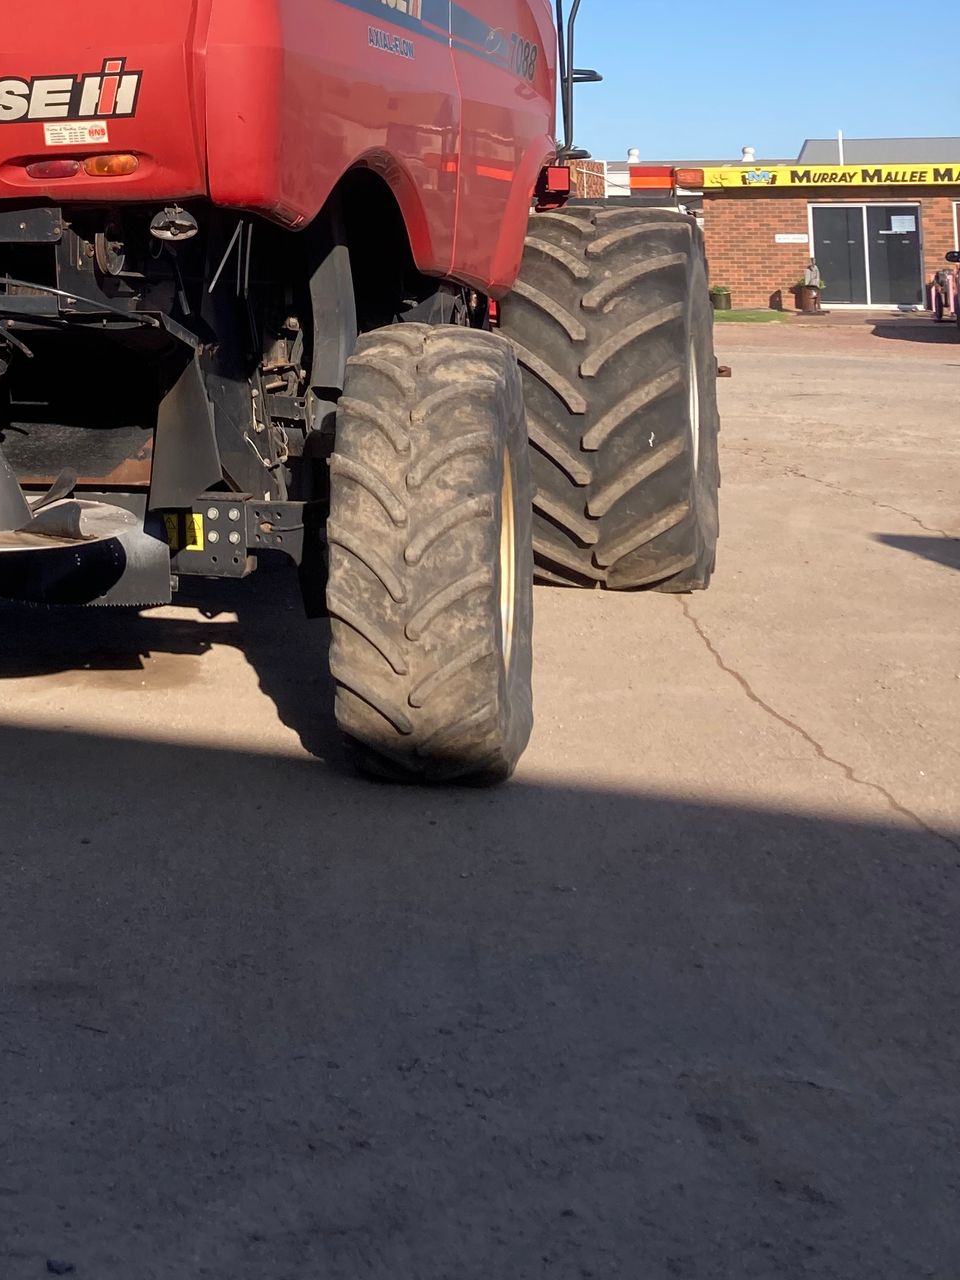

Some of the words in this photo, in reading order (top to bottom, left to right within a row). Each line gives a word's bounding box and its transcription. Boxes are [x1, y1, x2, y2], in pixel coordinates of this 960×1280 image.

[511, 32, 538, 81] 7088
[790, 170, 857, 183] MURRAY
[861, 169, 928, 183] MALLEE
